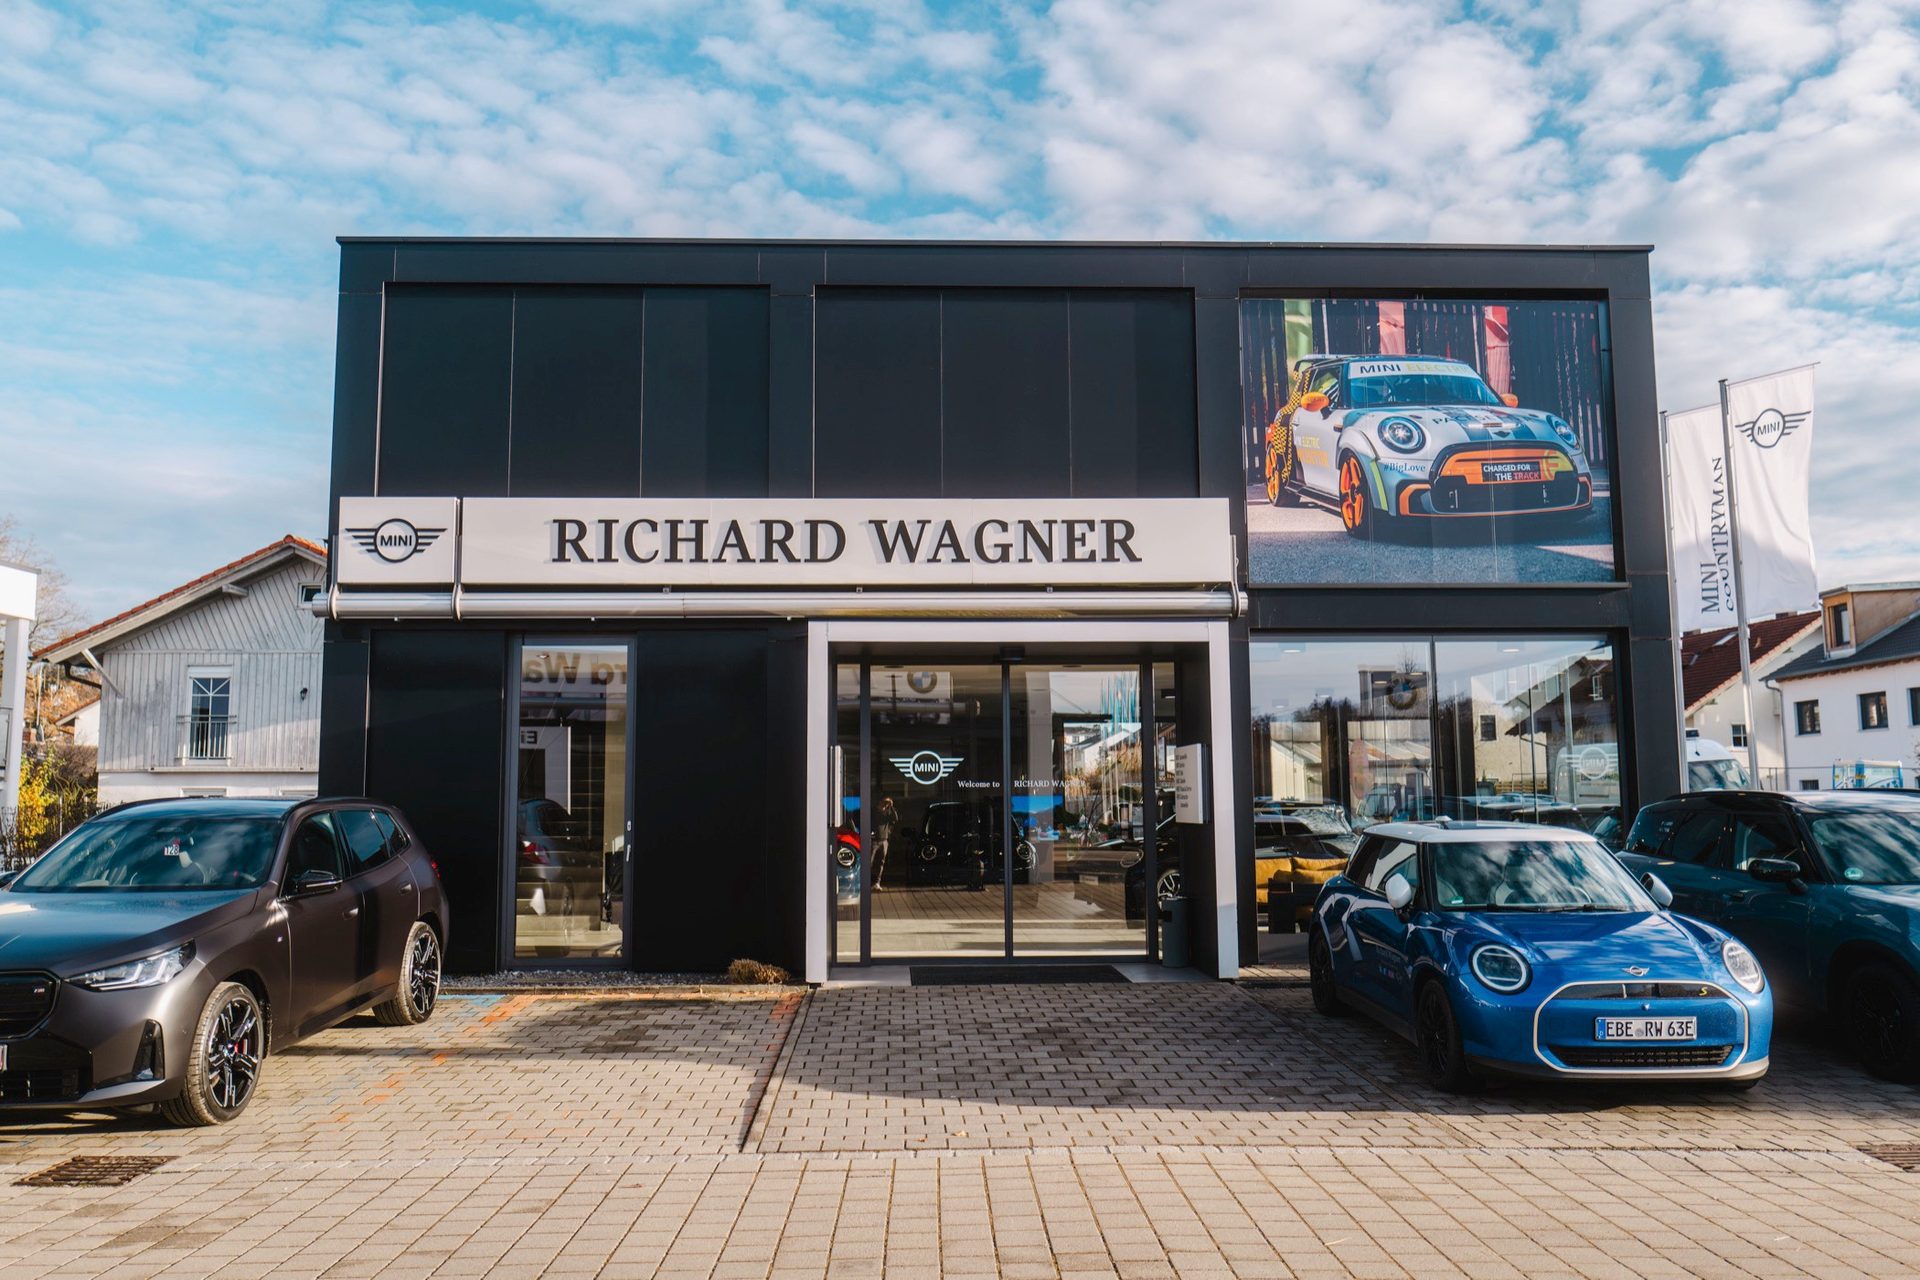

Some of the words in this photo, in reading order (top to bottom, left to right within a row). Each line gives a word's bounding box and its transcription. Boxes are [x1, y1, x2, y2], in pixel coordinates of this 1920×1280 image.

[1360, 364, 1400, 374] MINI
[1757, 421, 1780, 436] MINI
[1383, 462, 1426, 473] #BigLove
[1483, 464, 1516, 472] CHARGED
[1517, 463, 1531, 471] FOR
[1495, 472, 1513, 481] THE
[1513, 471, 1540, 480] TRACK
[1711, 457, 1734, 611] COUNTRYMAN
[380, 535, 412, 546] MINI
[552, 519, 846, 563] RICHARD
[868, 519, 1142, 563] WAGNER
[1700, 562, 1720, 613] MINI
[914, 763, 939, 772] MINI
[1014, 780, 1049, 788] RICHARD
[1606, 1021, 1633, 1037] EBE
[1645, 1021, 1663, 1037] RW
[1667, 1021, 1694, 1037] 63E
